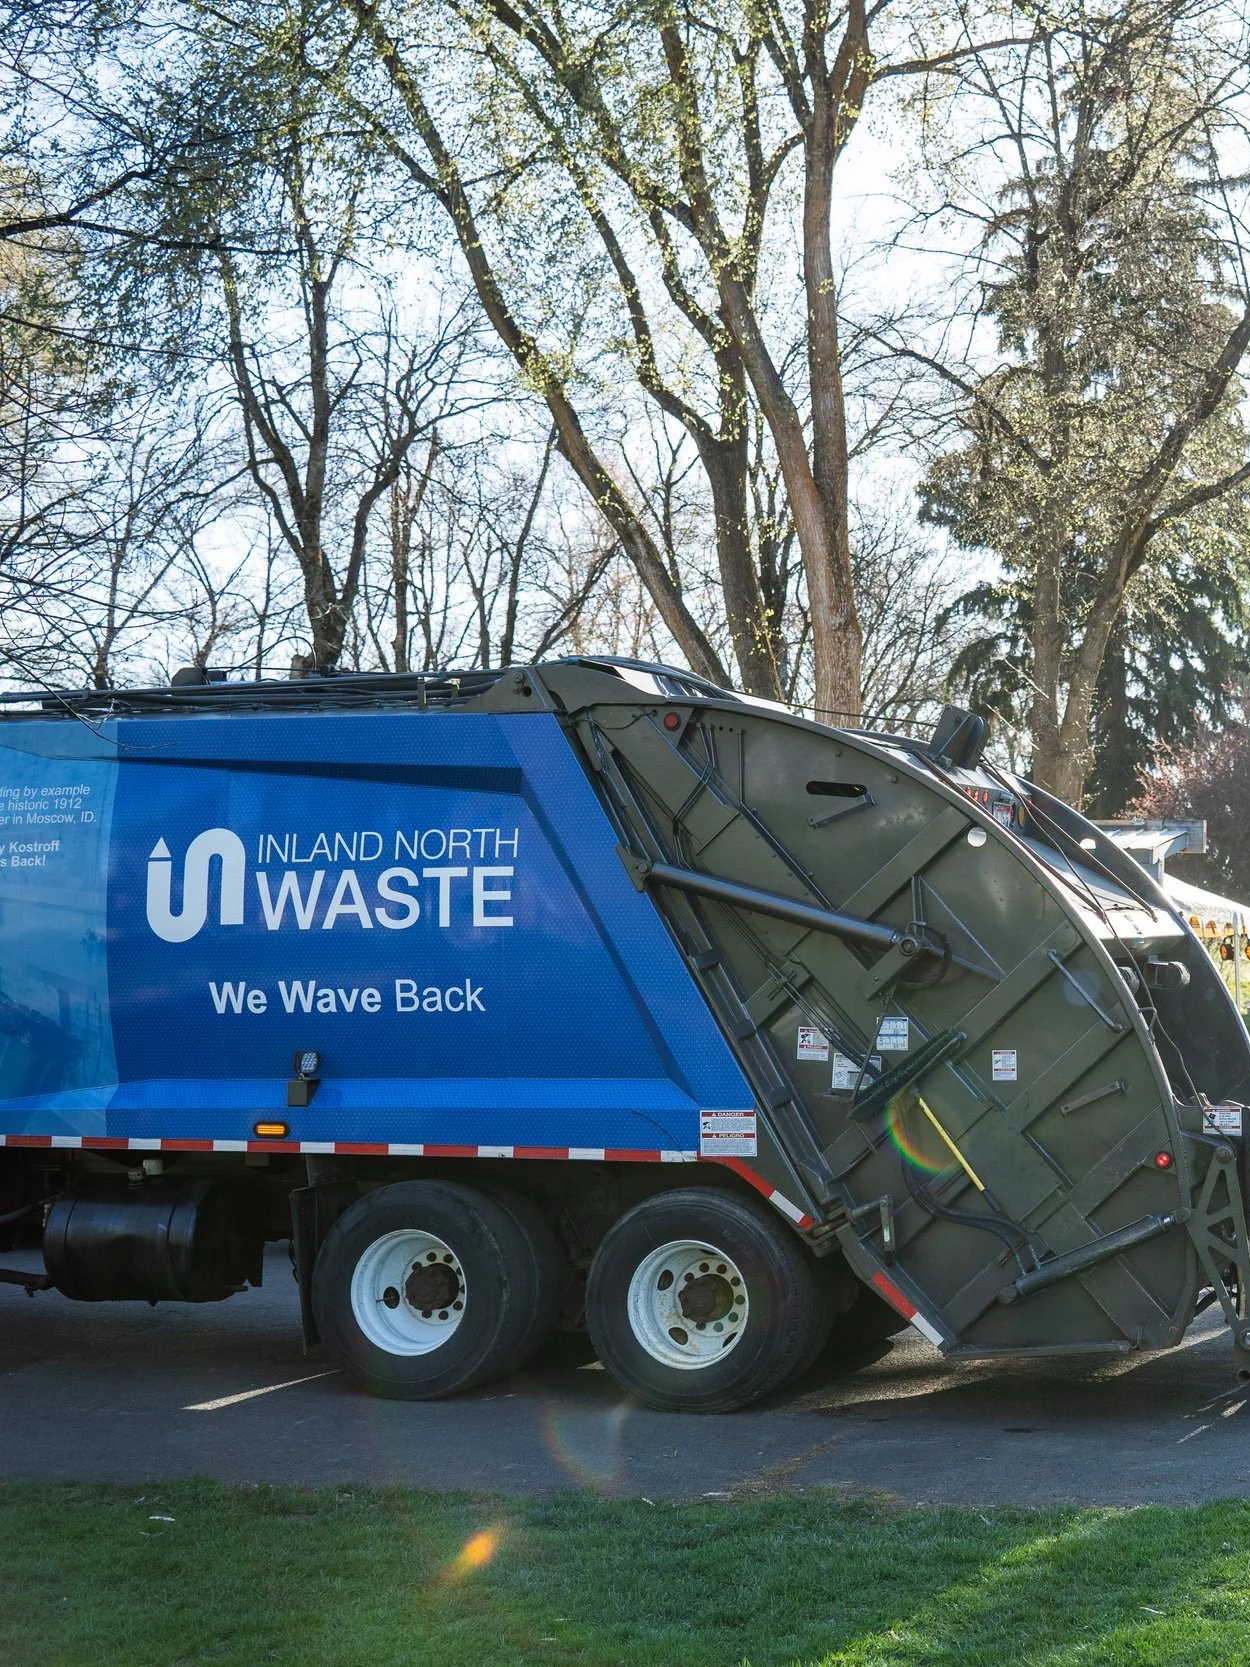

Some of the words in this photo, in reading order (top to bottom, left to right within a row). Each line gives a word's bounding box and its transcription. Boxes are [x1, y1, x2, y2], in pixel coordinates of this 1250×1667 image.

[23, 786, 38, 799] by
[41, 784, 91, 798] example
[8, 800, 49, 811] historic
[53, 797, 82, 810] 1912
[12, 814, 23, 825] in
[26, 812, 76, 825] Moscow,
[80, 811, 97, 823] ID.
[9, 840, 61, 853] Kostroff
[259, 832, 382, 863] INLAND
[395, 828, 518, 860] NORTH
[11, 855, 46, 867] Back!
[256, 866, 514, 930] WASTE
[209, 982, 267, 1014] We
[278, 980, 382, 1013] Wave
[396, 979, 486, 1012] Back
